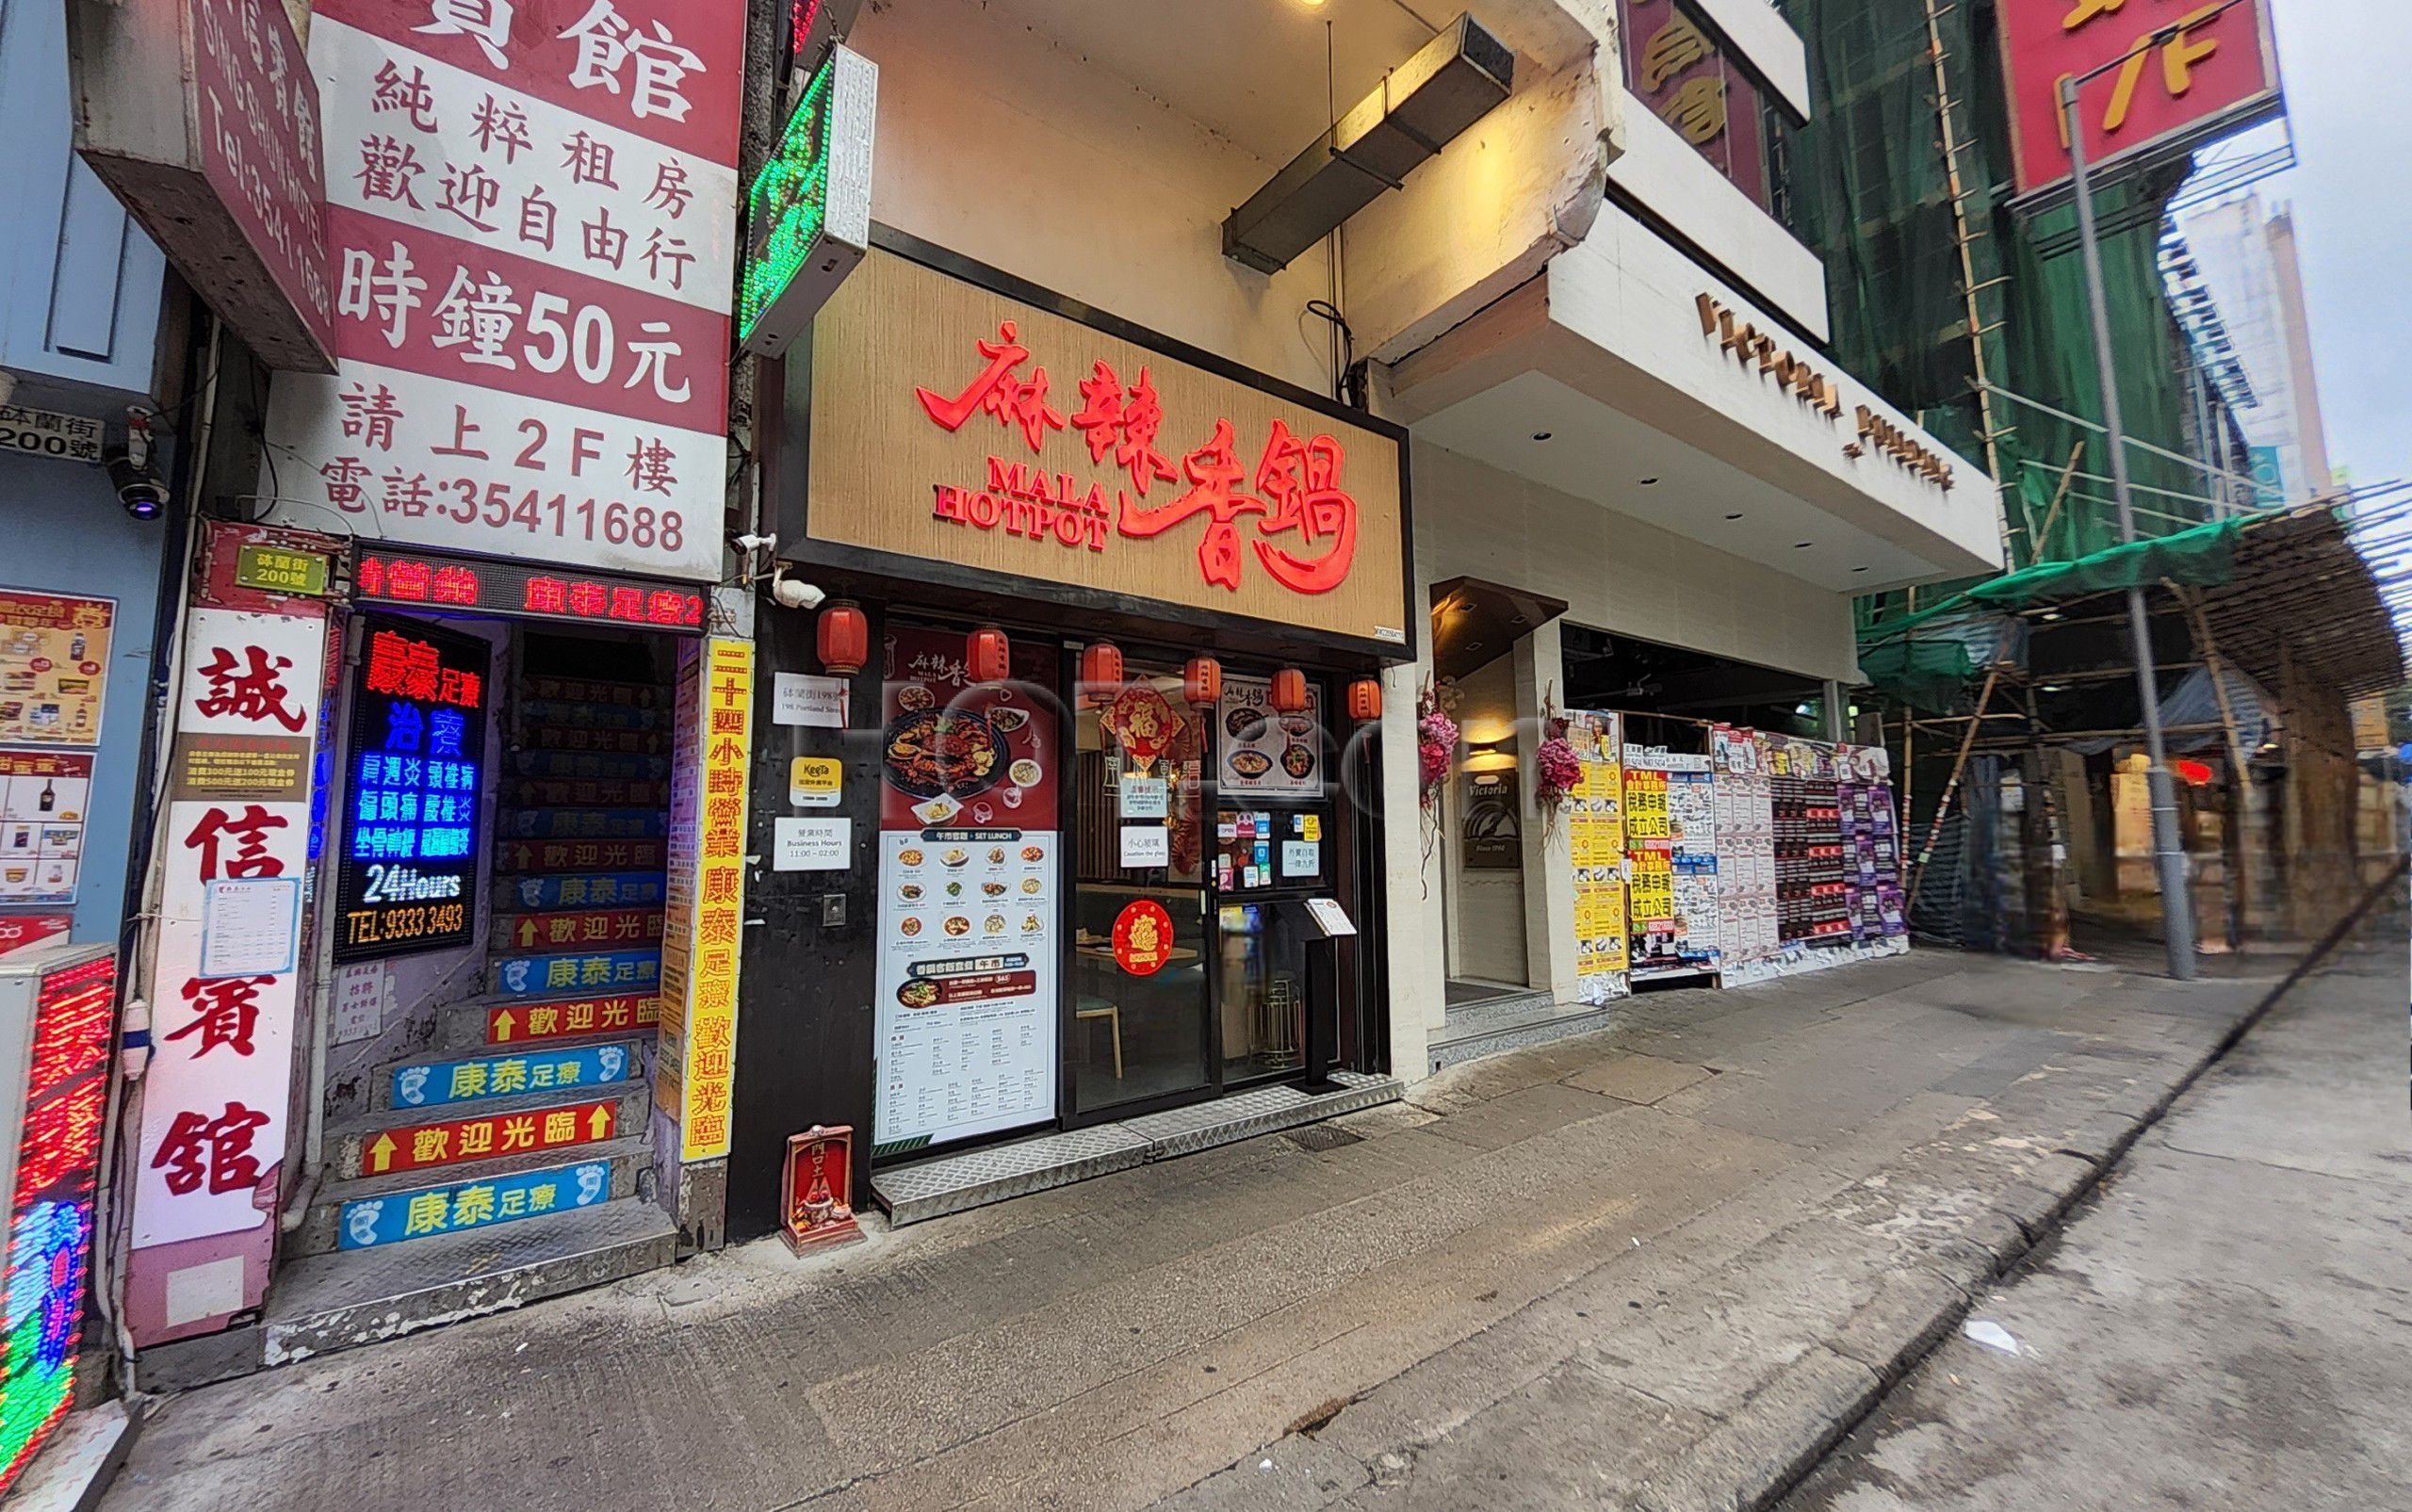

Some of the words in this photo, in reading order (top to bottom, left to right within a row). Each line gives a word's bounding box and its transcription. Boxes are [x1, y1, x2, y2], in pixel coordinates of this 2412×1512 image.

[373, 58, 694, 219] 純粹租房
[286, 156, 325, 262] HOTEL
[352, 135, 697, 290] 歡迎自由行
[338, 241, 692, 404] 時鐘50元
[0, 428, 98, 461] 200號
[339, 382, 677, 497] 請上2F樓
[915, 319, 1359, 595] 麻辣香鍋
[319, 458, 685, 553] 電話:35411688
[986, 456, 1111, 517] MALA
[932, 483, 1113, 552] HOTPOT
[255, 568, 307, 587] 200號
[1129, 700, 1159, 739] 福
[704, 649, 748, 858] 二十四小時營業
[804, 764, 830, 777] KeeTa
[1630, 771, 1662, 781] TML
[1469, 784, 1508, 796] Victoria
[787, 839, 820, 848] Business
[821, 838, 842, 847] Hours
[1635, 851, 1666, 862] TML
[363, 863, 462, 903] 24Hours
[703, 867, 739, 1009] 康泰足療
[546, 955, 657, 988] 康泰足療
[528, 998, 660, 1036] 歡迎光臨
[448, 1058, 582, 1099] 康泰足療
[689, 1015, 730, 1146] 歡迎光臨
[412, 1111, 578, 1162] 歡迎光臨
[404, 1183, 557, 1237] 康泰足療
